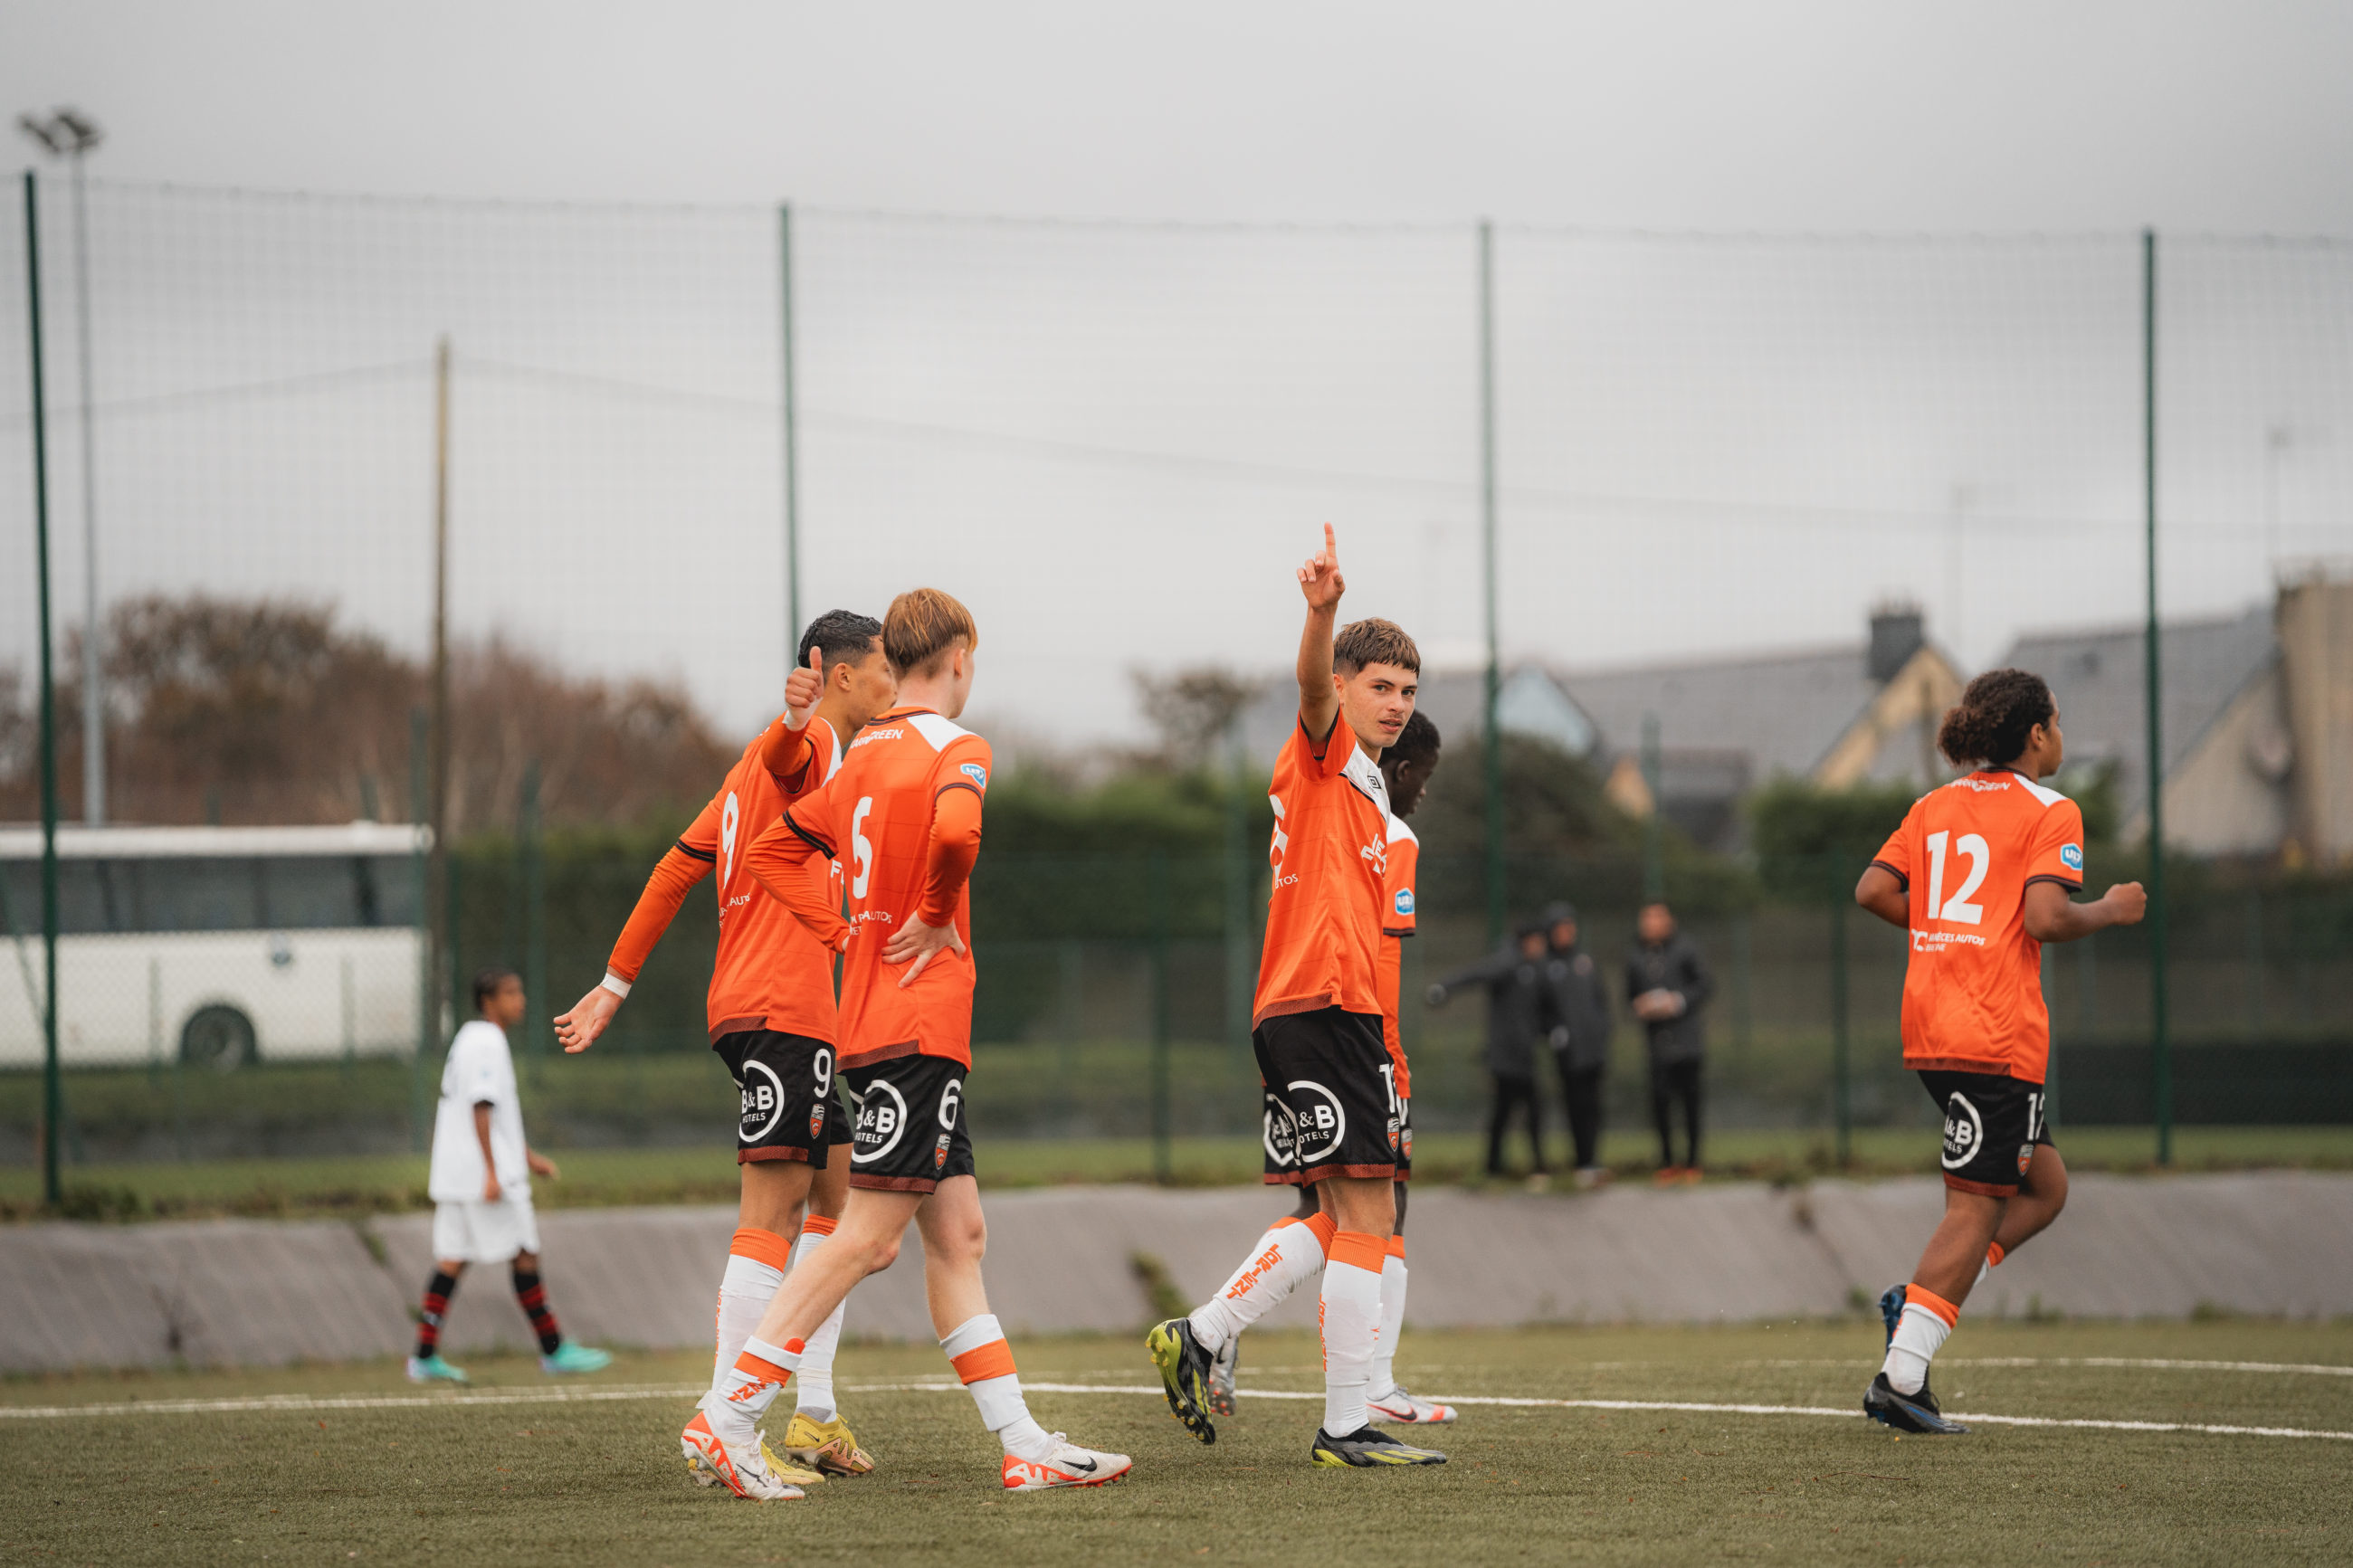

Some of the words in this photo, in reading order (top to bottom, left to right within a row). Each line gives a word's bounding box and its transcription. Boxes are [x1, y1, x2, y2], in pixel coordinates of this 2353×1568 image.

[721, 790, 739, 890] 9
[1927, 830, 1990, 925] 12
[1956, 933, 1986, 947] AUTOS
[813, 1048, 832, 1098] 9
[938, 1079, 962, 1131] 6
[1299, 1130, 1329, 1144] OTELS
[1226, 1243, 1282, 1299] LORIENT
